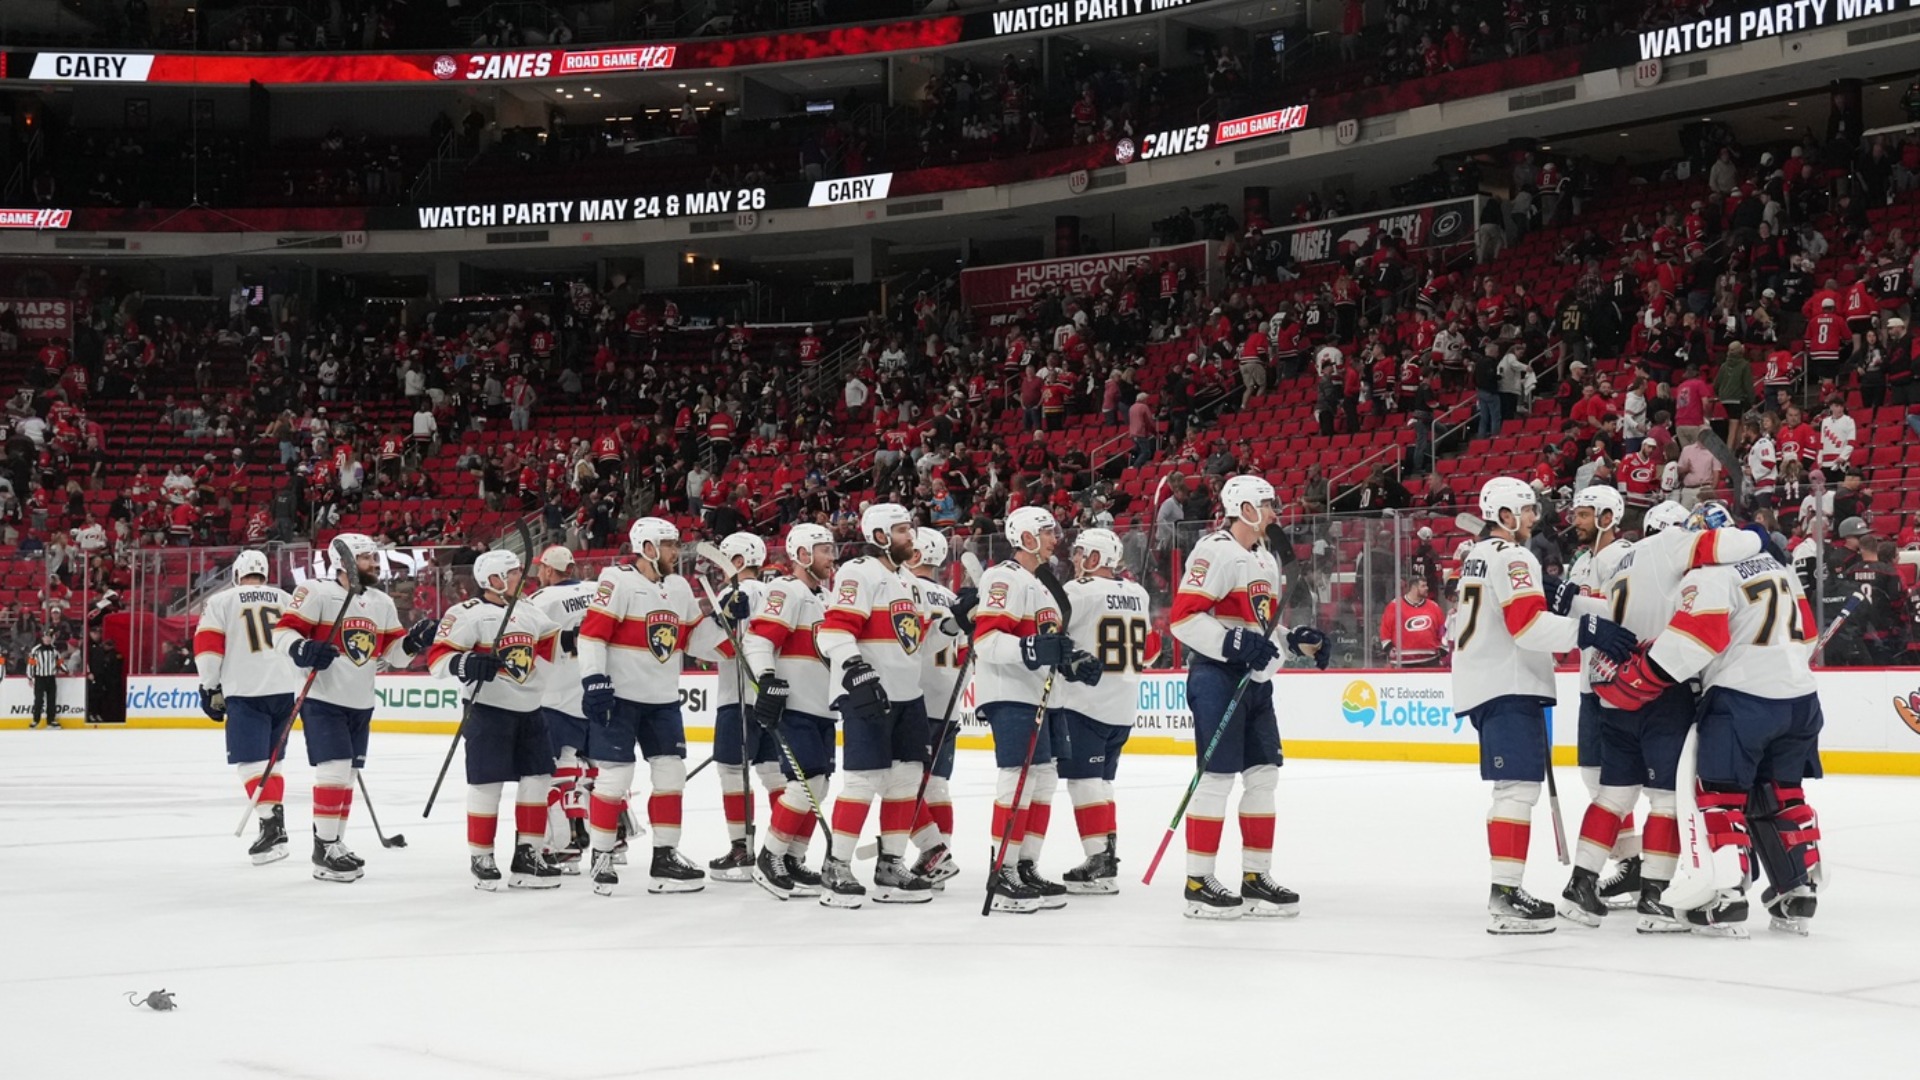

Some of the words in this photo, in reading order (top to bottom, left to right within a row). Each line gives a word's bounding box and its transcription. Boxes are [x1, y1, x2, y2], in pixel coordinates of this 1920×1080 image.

[993, 3, 1069, 35] WATCH
[1639, 15, 1731, 60] WATCH
[1740, 0, 1827, 41] PARTY
[55, 55, 127, 78] CARY
[466, 52, 553, 80] CANES
[566, 54, 599, 69] ROAD
[602, 52, 638, 67] GAME
[637, 46, 669, 71] HQ
[1638, 63, 1657, 79] 118
[1141, 124, 1210, 160] CANES
[1222, 121, 1248, 138] ROAD
[1249, 115, 1278, 133] GAME
[1277, 105, 1305, 133] HQ
[1338, 125, 1355, 139] 117
[1070, 174, 1086, 188] 116
[827, 179, 875, 203] CARY
[418, 204, 496, 229] WATCH
[502, 201, 572, 225] PARTY
[579, 198, 628, 222] MAY
[632, 197, 660, 218] 24
[665, 194, 680, 216] &
[685, 191, 732, 214] MAY
[737, 188, 767, 210] 26
[34, 208, 64, 230] HQ
[737, 214, 754, 227] 115
[345, 233, 364, 246] 114
[1379, 267, 1386, 282] 7
[1883, 274, 1900, 292] 37
[1614, 280, 1623, 297] 11
[1306, 310, 1320, 325] 20
[1562, 310, 1580, 330] 24
[1818, 324, 1829, 344] 8
[383, 441, 396, 453] 20
[602, 438, 615, 451] 20
[1025, 450, 1044, 465] 20
[239, 591, 279, 604] BARKOV
[912, 585, 921, 604] A
[1106, 594, 1142, 611] SCHMIDT
[1098, 615, 1147, 673] 88
[127, 685, 202, 709] icketm
[375, 688, 458, 708] NUCOR
[1380, 687, 1395, 699] NC
[1397, 687, 1445, 699] Education
